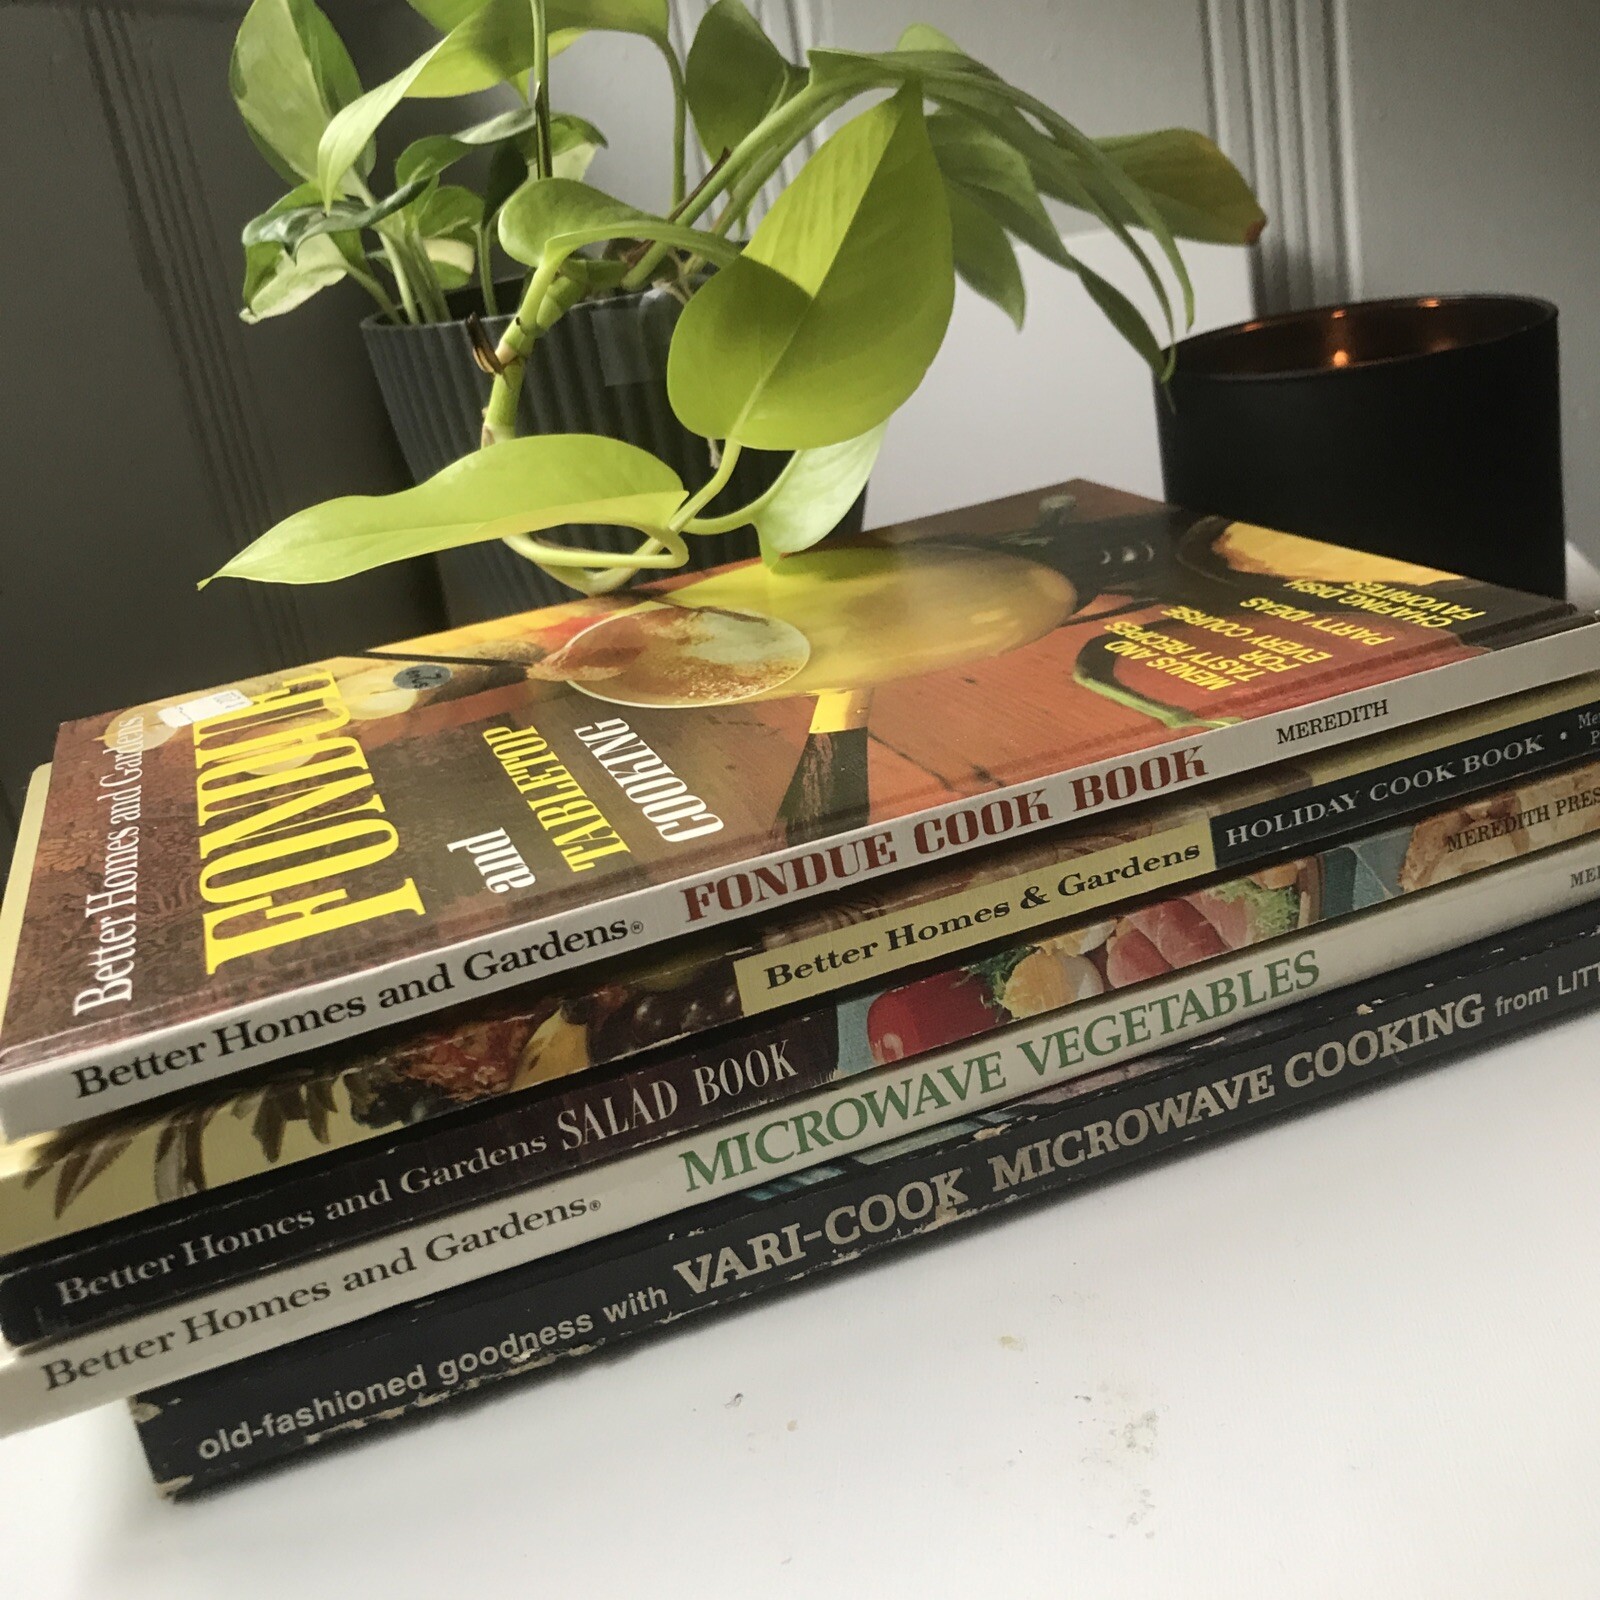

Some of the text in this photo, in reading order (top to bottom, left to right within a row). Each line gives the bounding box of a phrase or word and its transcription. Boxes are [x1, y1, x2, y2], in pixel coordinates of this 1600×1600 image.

[1104, 621, 1266, 682] TASTY RECIPES
[1161, 606, 1333, 663] EVERY COURSE
[1240, 597, 1395, 646] PARTY IDEAS
[1283, 579, 1453, 628] CHAFING DISH
[1344, 580, 1486, 621] FAVORITES
[1104, 640, 1236, 691] MENUS AND
[1239, 650, 1301, 673] FOR
[573, 718, 725, 842] COOKING
[1276, 699, 1389, 745] MEREDITH
[192, 671, 426, 975] FONDUE
[482, 725, 632, 873] TABLETOP
[680, 745, 1209, 922] FONDUE COOK BOOK
[1225, 734, 1544, 847] HOLIDAY COOK BOOK
[1447, 804, 1550, 853] MEREDITH
[73, 716, 145, 1016] Better Homes and Gardens
[446, 827, 537, 893] and
[763, 844, 1201, 990] Better Homes & Gardens
[71, 1040, 207, 1099] Better
[212, 995, 367, 1057] Homes
[378, 963, 455, 1009] and
[678, 949, 1320, 1192] MICROWAVE VEGETABLES
[56, 1039, 799, 1306] Better Homes and Gardens SALAD BOOK
[199, 1365, 427, 1459] old-fashioned
[438, 1312, 594, 1388] goodness
[602, 1286, 669, 1324] with
[673, 1167, 970, 1296] VARI-COOK
[987, 1063, 1275, 1193] MICROWAVE
[1284, 993, 1485, 1088] COOKING
[1494, 984, 1549, 1018] from
[41, 1330, 176, 1391] Better
[181, 1281, 331, 1344] Homes
[342, 1246, 418, 1291] and
